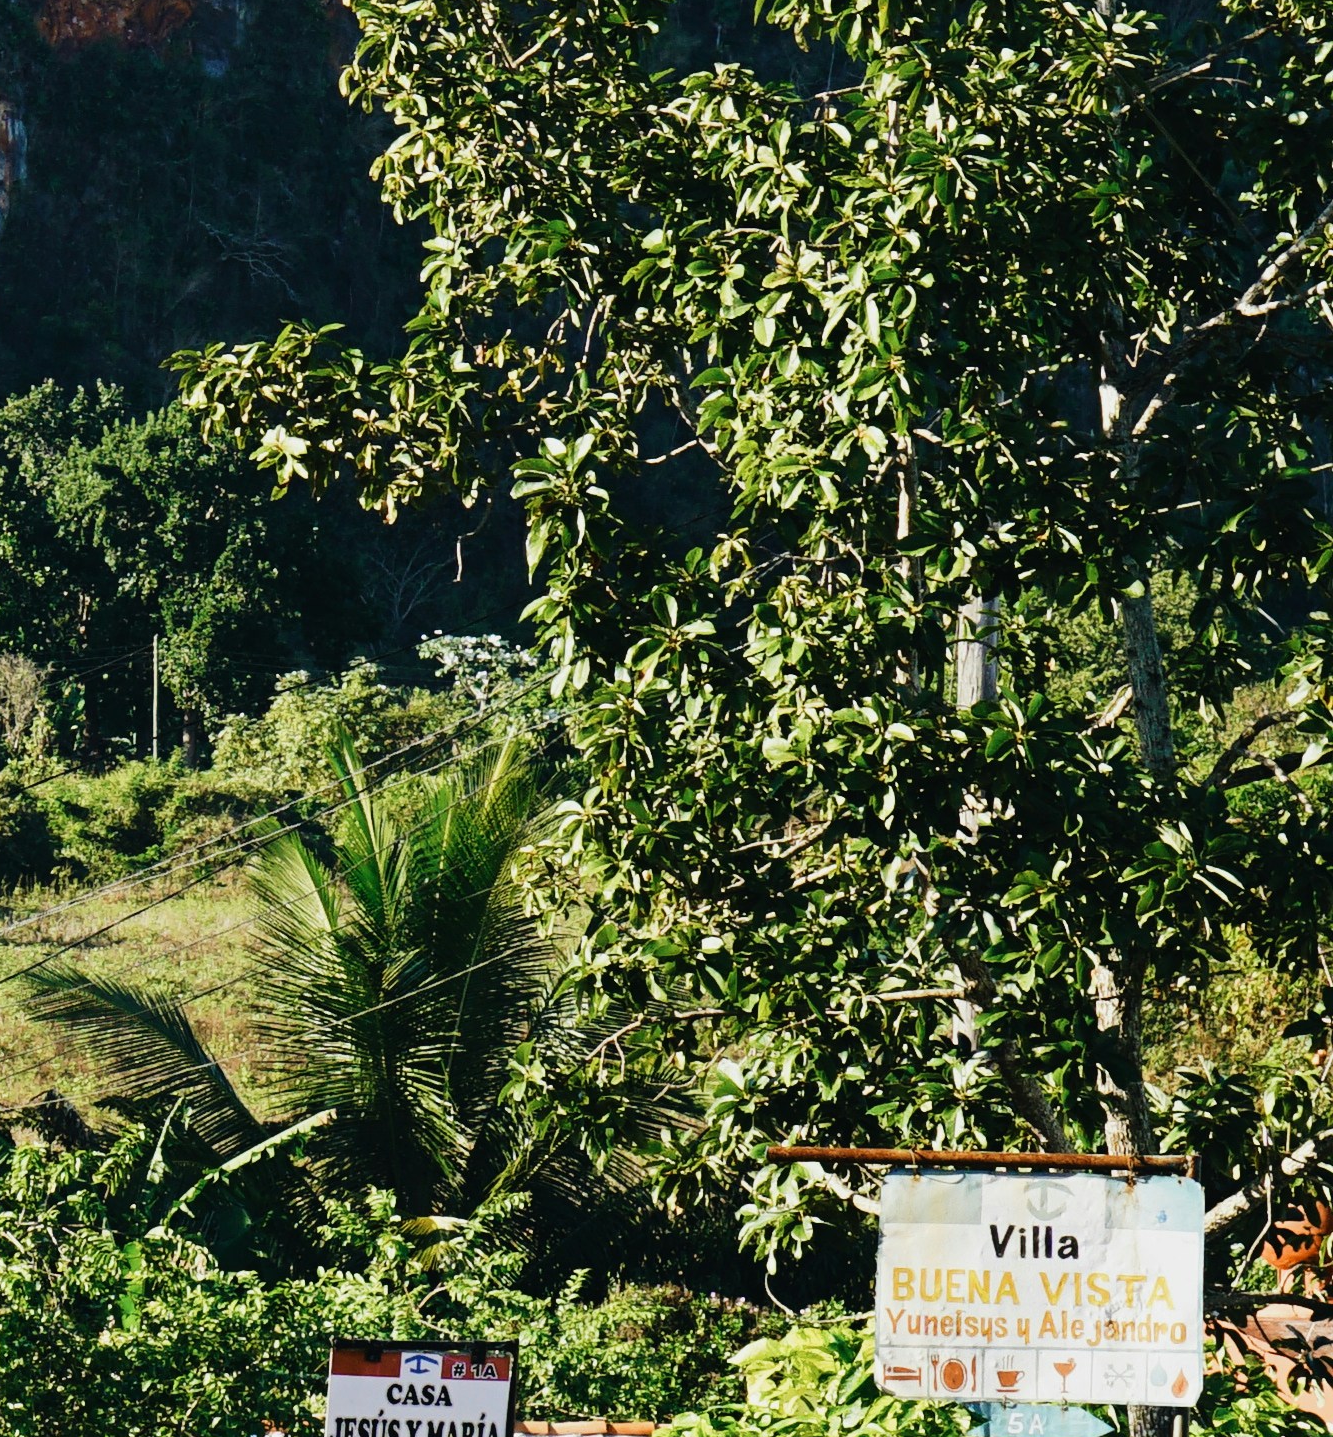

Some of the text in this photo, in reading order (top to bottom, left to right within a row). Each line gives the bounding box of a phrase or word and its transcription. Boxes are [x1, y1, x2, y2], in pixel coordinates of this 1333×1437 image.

[989, 1224, 1080, 1260] Villa
[891, 1267, 1175, 1310] BUENA VISTA
[885, 1307, 1009, 1344] Yuneisys
[1017, 1317, 1031, 1345] y
[471, 1363, 498, 1379] 1A
[386, 1383, 453, 1407] CASA
[1006, 1412, 1045, 1435] 5A
